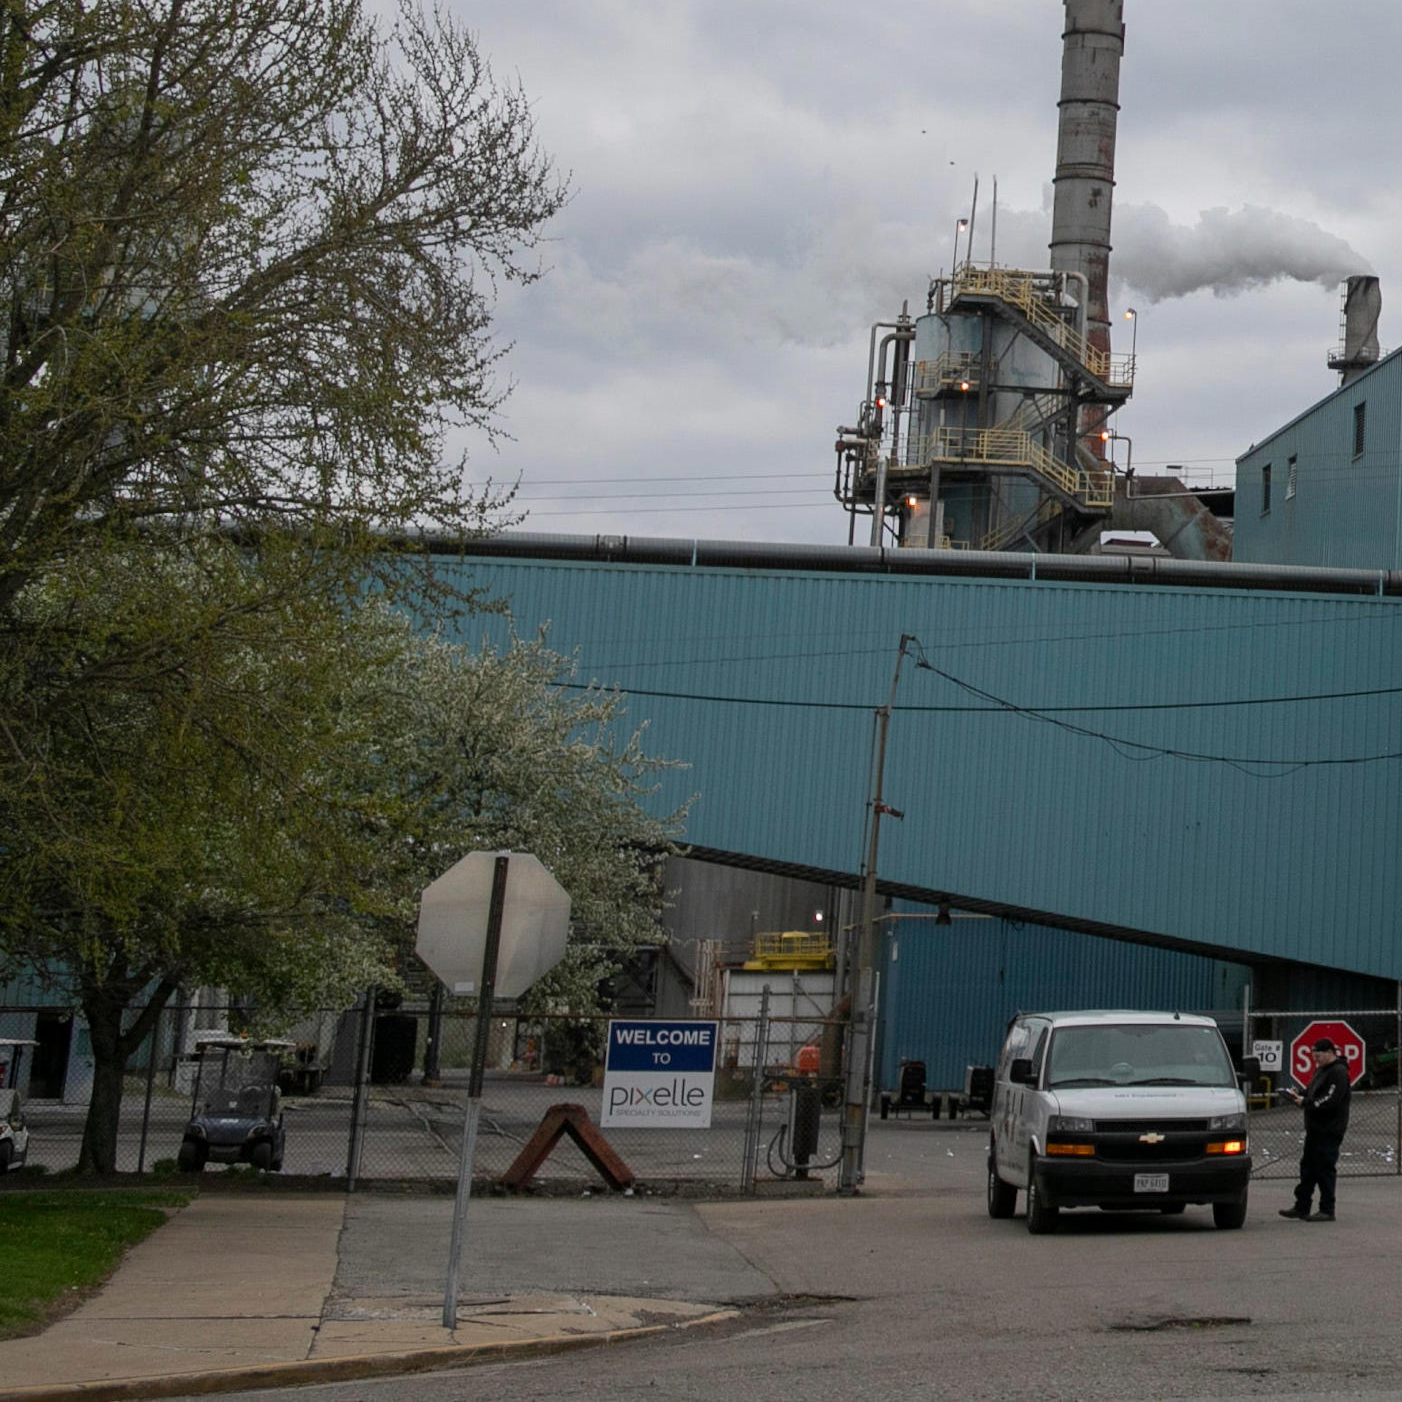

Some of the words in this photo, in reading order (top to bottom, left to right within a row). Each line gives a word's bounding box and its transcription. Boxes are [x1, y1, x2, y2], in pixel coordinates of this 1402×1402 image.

[615, 1029, 711, 1046] WELCOME
[652, 1052, 671, 1065] TO
[1258, 1052, 1276, 1063] 10
[609, 1078, 705, 1116] pixelle
